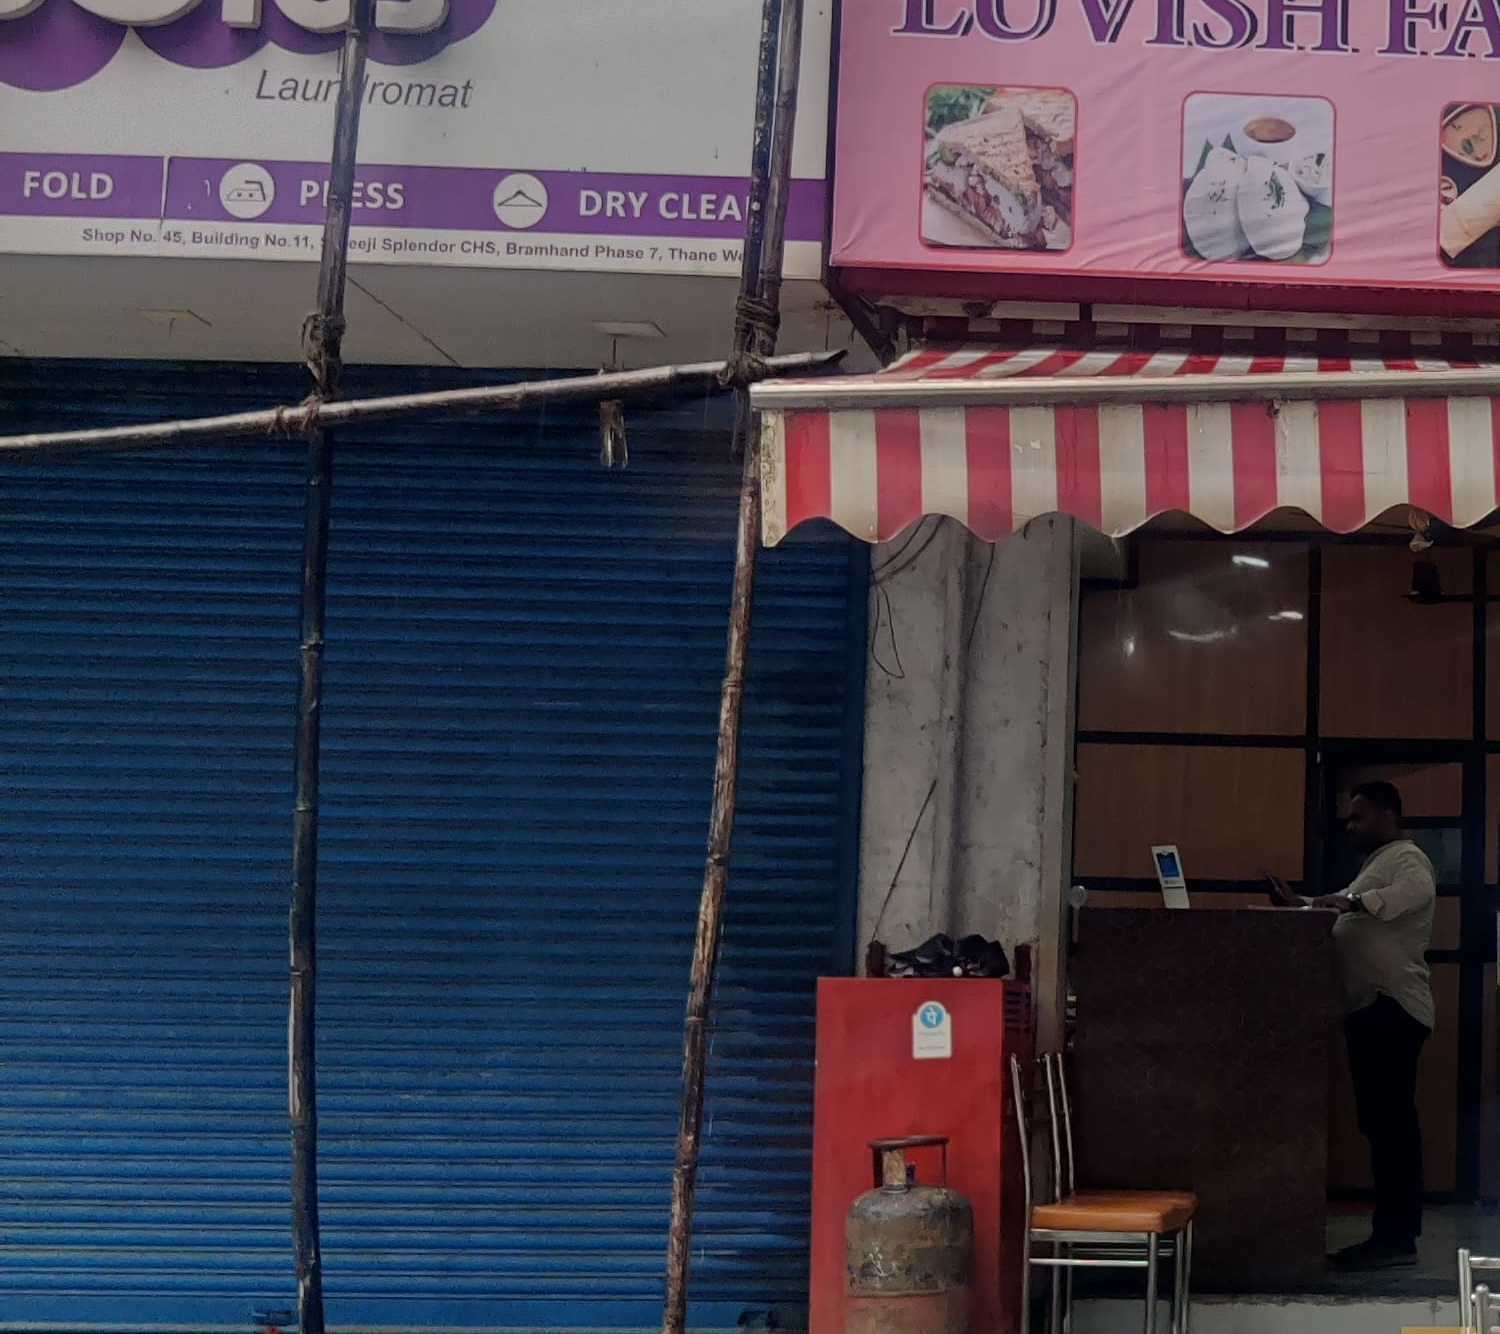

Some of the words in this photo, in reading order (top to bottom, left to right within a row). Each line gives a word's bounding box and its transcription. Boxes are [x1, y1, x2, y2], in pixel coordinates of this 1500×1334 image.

[255, 68, 474, 109] Launromat
[22, 170, 115, 200] FOLD
[578, 189, 649, 218] DRY
[658, 192, 751, 222] CLEA
[82, 228, 125, 244] Shop
[130, 230, 157, 243] No.
[163, 230, 187, 246] 45,
[191, 230, 260, 249] Building
[381, 237, 457, 255] Splendor
[460, 240, 500, 257] CHS,
[506, 242, 589, 258] Bramhand
[594, 244, 645, 260] Phase
[648, 247, 663, 262] 7,
[668, 247, 718, 263] Thane
